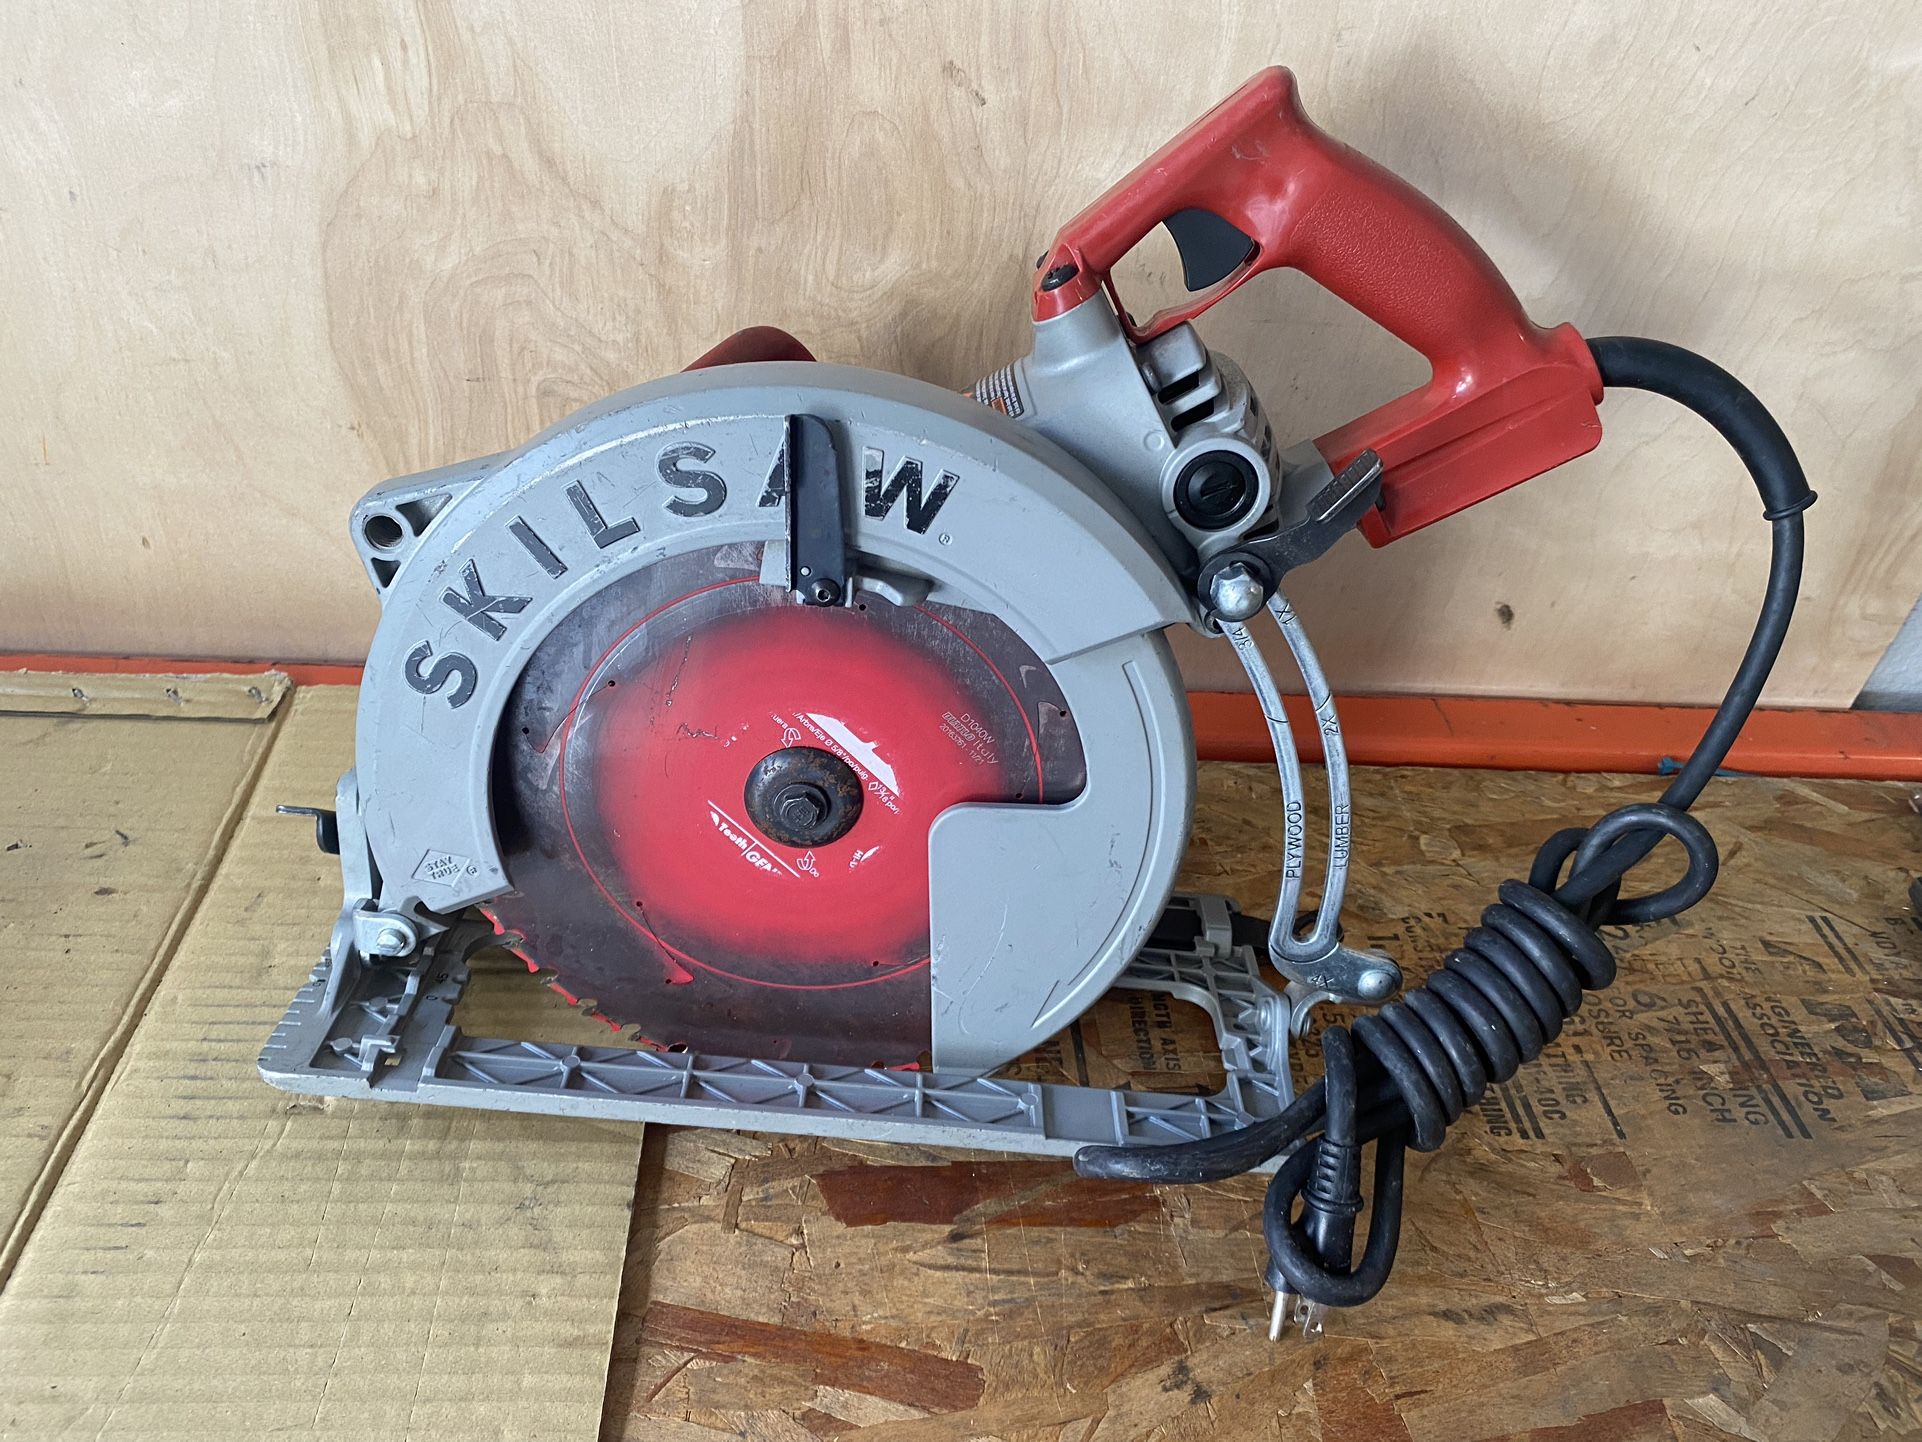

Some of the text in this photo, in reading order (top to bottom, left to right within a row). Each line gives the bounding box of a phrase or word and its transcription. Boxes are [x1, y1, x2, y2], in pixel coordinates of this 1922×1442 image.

[960, 713, 996, 744] D1040W
[1285, 800, 1303, 879] PLYWOOD
[1332, 803, 1350, 868] LUMBER
[424, 855, 453, 873] STAY
[431, 862, 461, 881] TRUE
[1159, 1036, 1182, 1072] AXIS
[1626, 1029, 1688, 1117] SPACING
[1764, 996, 1845, 1100] NGINEERED
